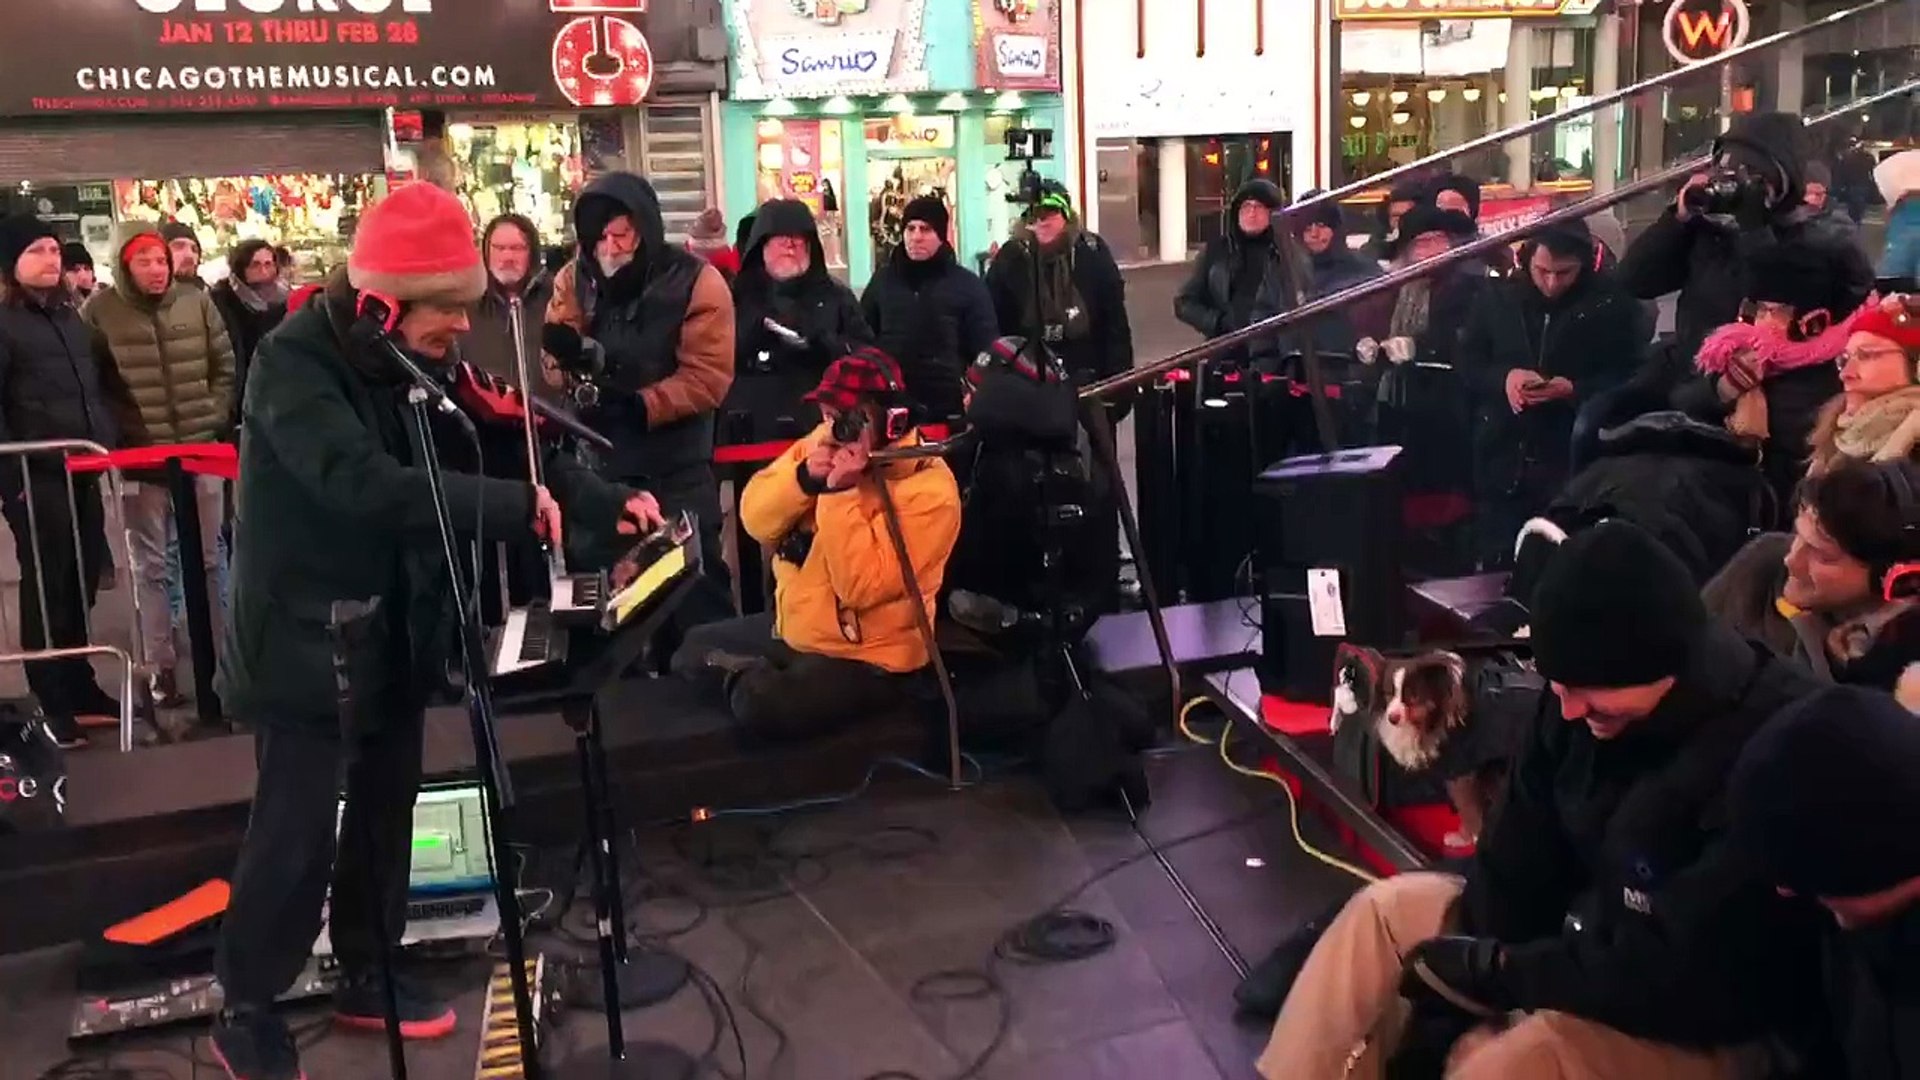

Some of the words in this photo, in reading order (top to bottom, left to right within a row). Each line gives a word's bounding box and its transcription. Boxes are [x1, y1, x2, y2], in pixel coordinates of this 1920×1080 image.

[159, 19, 214, 43] JAN
[224, 21, 253, 43] 12
[261, 18, 329, 43] THRU
[336, 20, 379, 43] FEB
[386, 20, 418, 43] 28
[1677, 8, 1733, 51] W
[781, 48, 878, 75] Sanrio
[76, 64, 496, 91] CHICAGOTHEMUSICAL.COM
